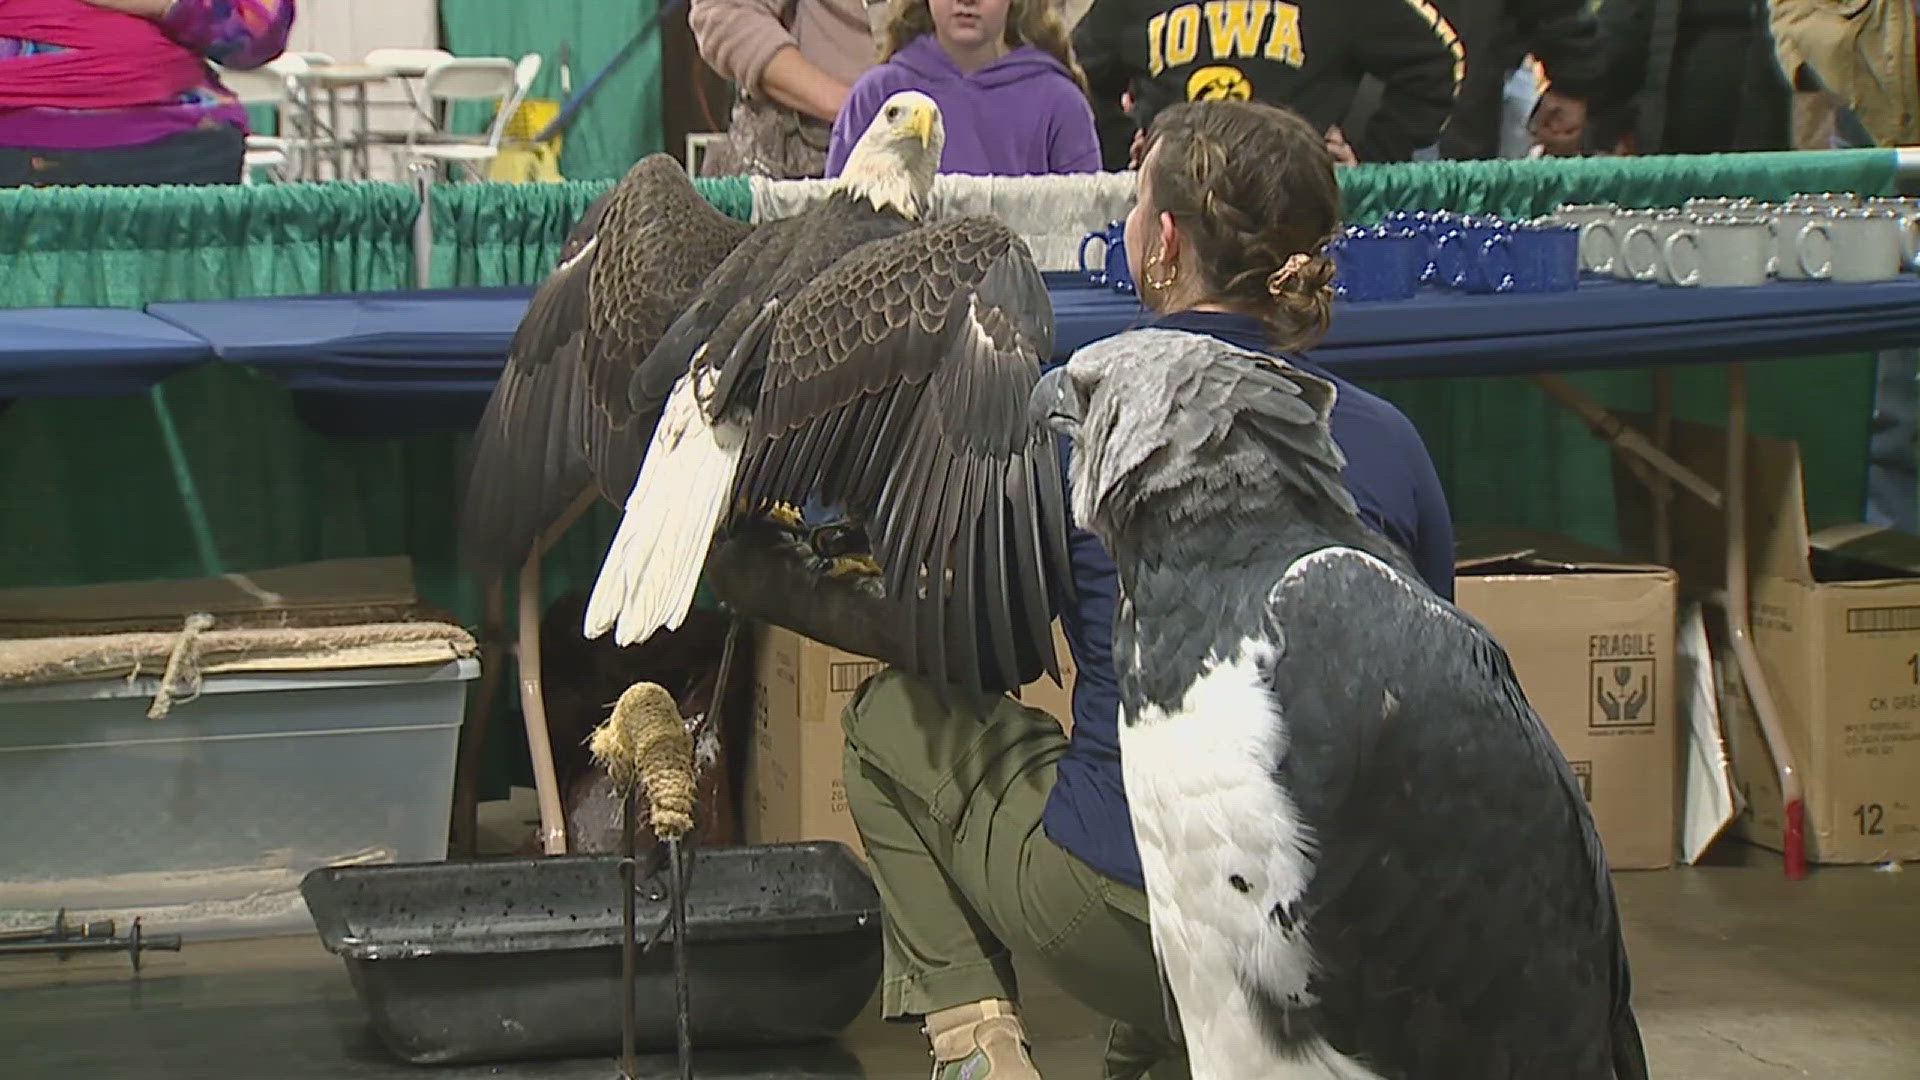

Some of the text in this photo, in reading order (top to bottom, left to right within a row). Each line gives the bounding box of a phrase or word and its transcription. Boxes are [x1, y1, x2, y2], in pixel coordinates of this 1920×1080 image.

[1148, 0, 1306, 78] IOWA
[1588, 633, 1656, 657] FRAGILE
[1853, 803, 1884, 836] 12
